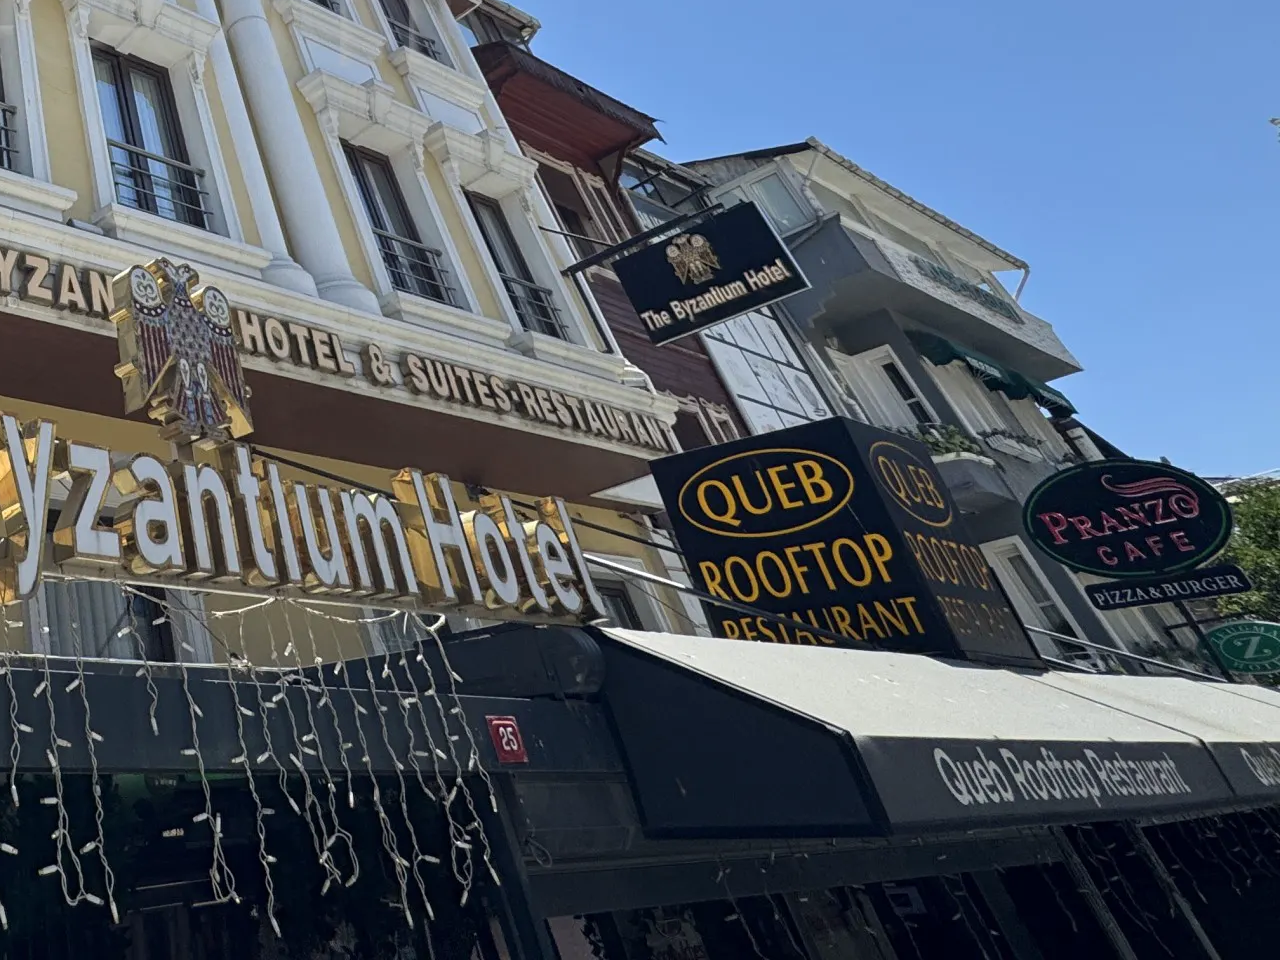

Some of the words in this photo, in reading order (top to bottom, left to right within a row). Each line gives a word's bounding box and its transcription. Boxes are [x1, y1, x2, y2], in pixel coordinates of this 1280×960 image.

[640, 309, 673, 332] The
[743, 258, 792, 292] Hotel
[234, 309, 356, 378] HOTEL
[361, 342, 396, 386] &
[696, 460, 834, 527] QUEB
[878, 456, 944, 508] QUEB
[396, 467, 610, 624] Hotel
[1036, 493, 1200, 545] PRANZO
[1097, 530, 1197, 566] CAFE
[699, 533, 893, 605] ROOFTOP
[903, 530, 994, 591] ROOFTOP
[499, 726, 518, 751] 25
[933, 746, 1014, 805] Queb
[999, 746, 1102, 808] Rooftop
[1084, 749, 1192, 797] Restaurant
